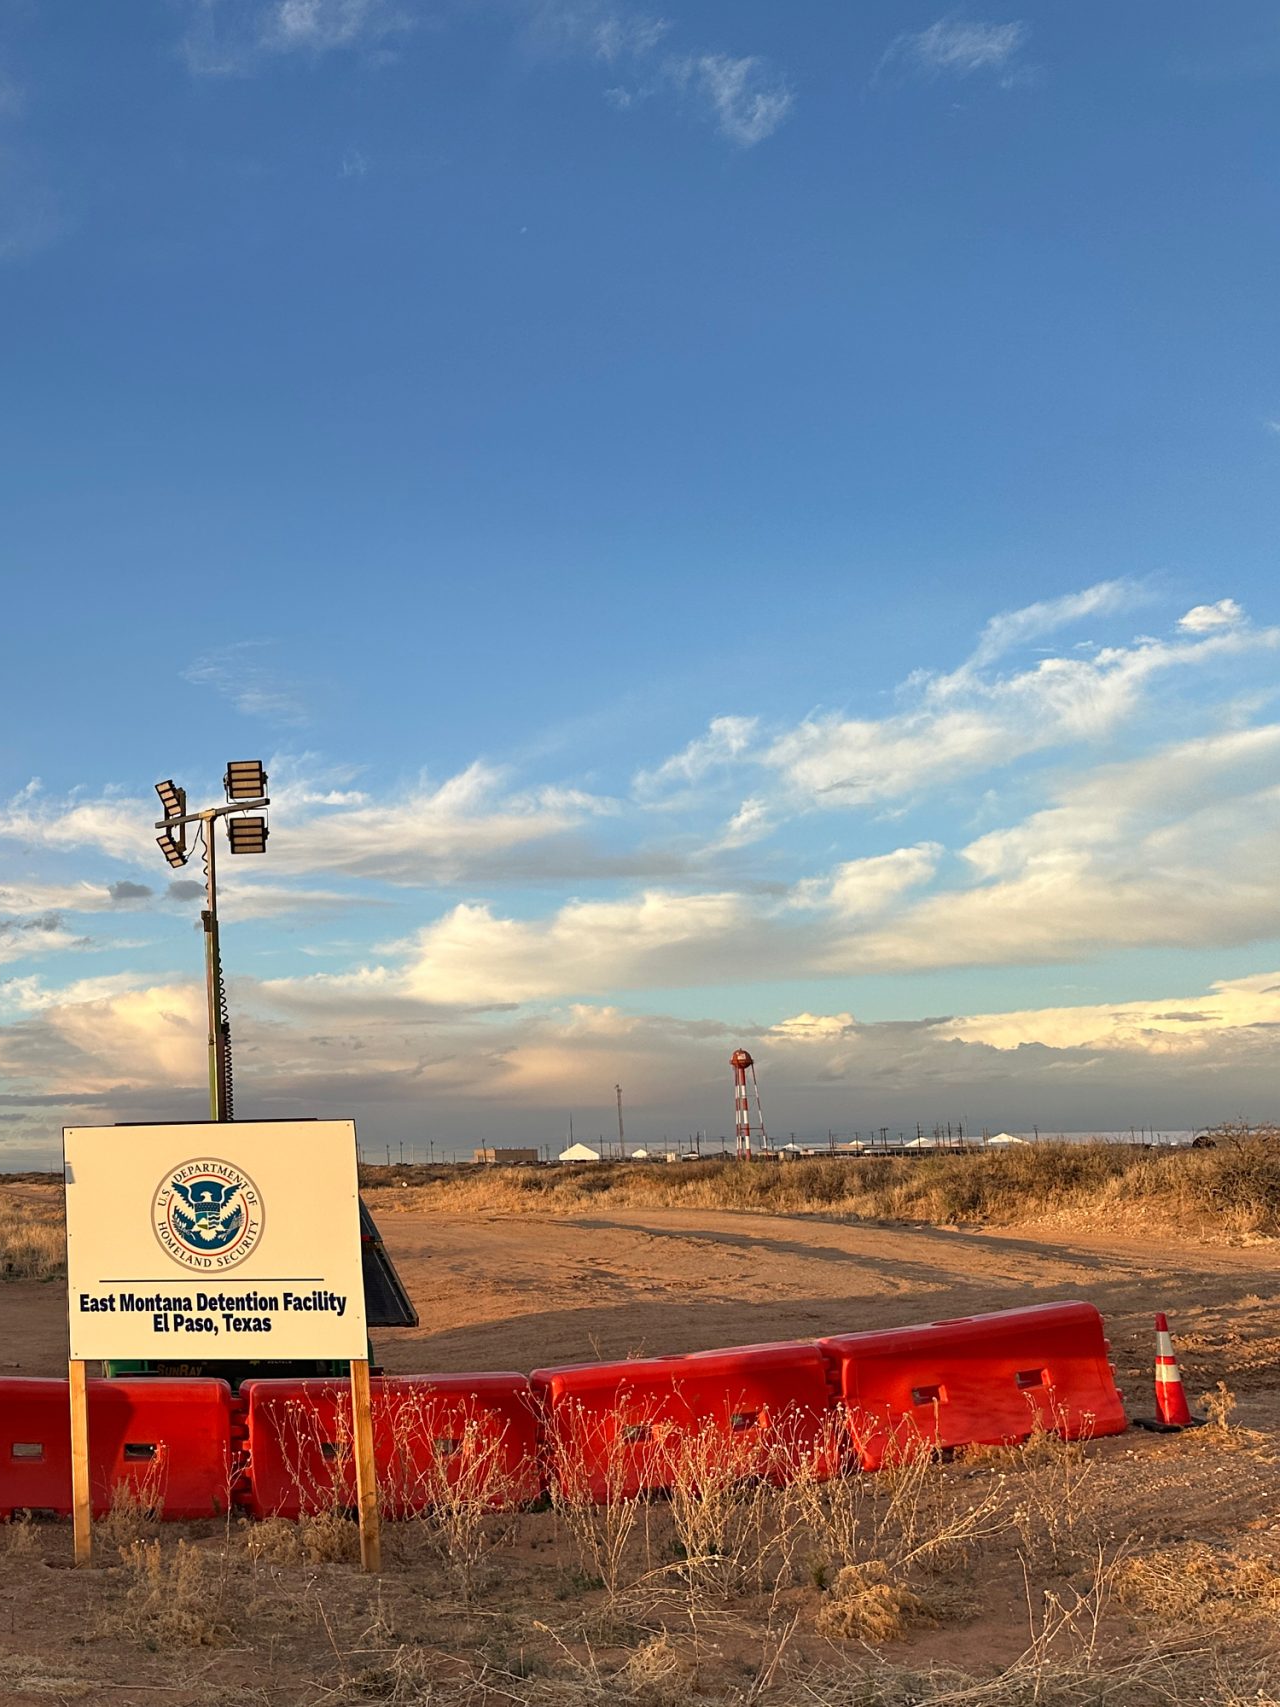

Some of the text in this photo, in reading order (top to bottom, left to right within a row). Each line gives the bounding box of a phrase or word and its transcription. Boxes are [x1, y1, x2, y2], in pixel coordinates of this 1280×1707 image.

[158, 1164, 258, 1206] U.S. DEPARTMENT OF
[158, 1220, 258, 1267] HOMELAND SECURITY
[80, 1291, 346, 1316] East Montana Detention Facility
[153, 1313, 271, 1336] El Paso, Texas
